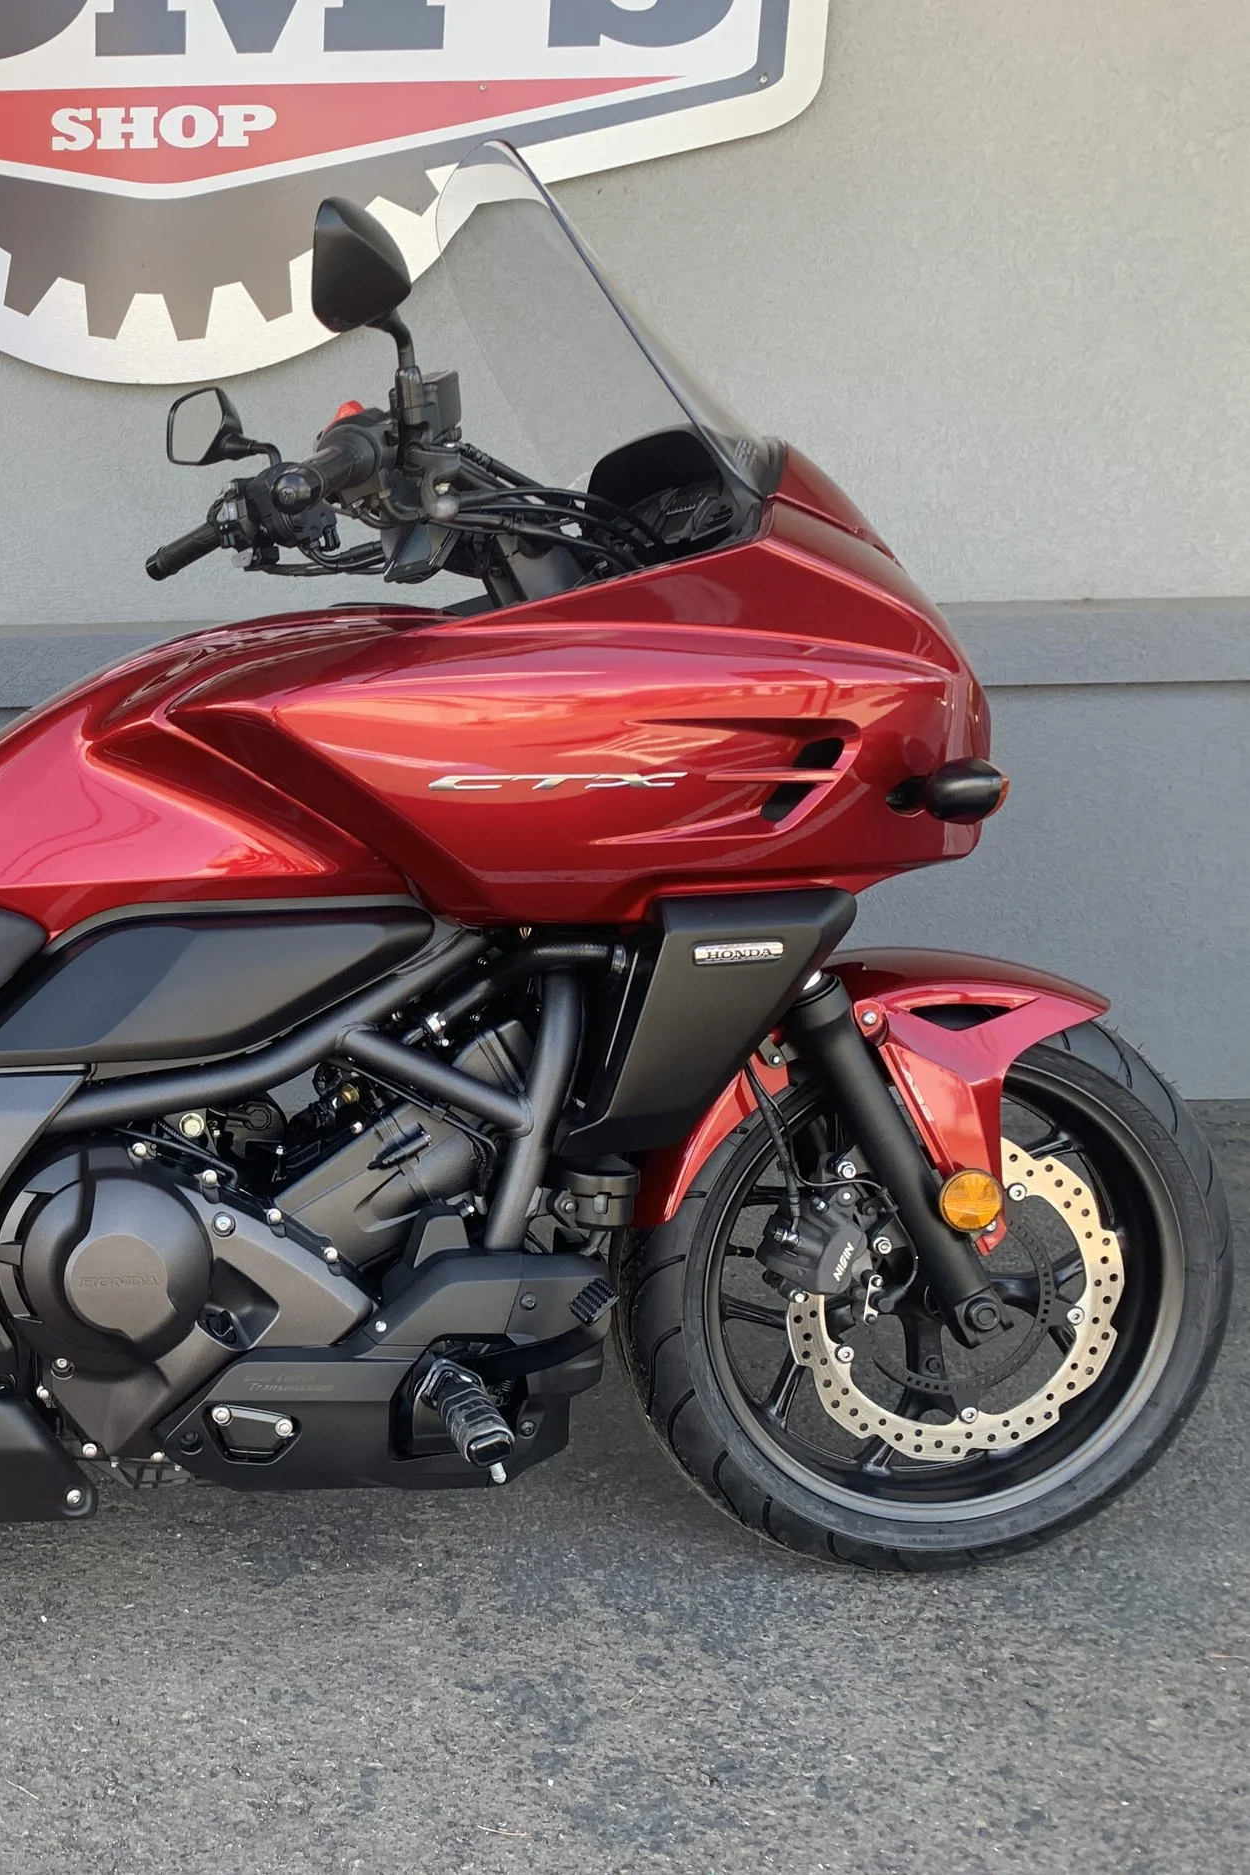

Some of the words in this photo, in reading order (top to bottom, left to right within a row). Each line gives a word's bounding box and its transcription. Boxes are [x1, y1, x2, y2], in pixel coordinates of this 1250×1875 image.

[52, 104, 278, 152] SHOP
[428, 772, 688, 791] CTX
[706, 948, 772, 960] HONDA
[78, 1275, 160, 1288] HONDA
